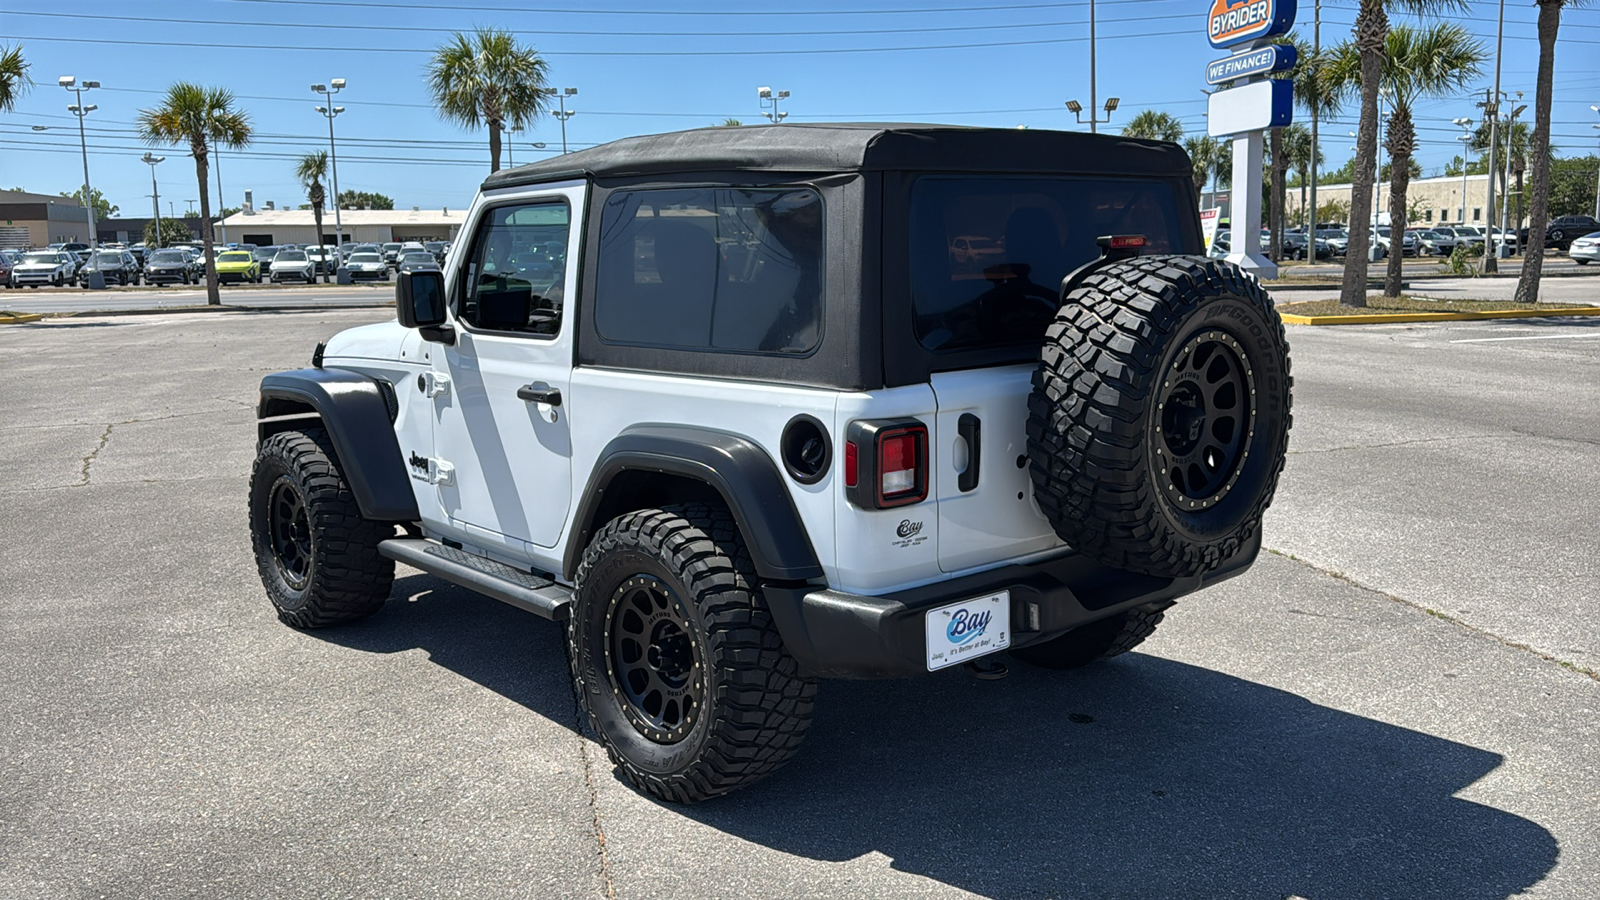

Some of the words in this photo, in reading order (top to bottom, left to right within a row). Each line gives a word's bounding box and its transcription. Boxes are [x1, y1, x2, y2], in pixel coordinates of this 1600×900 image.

[1211, 1, 1267, 36] BYRIDER
[1210, 65, 1224, 79] WE
[1225, 52, 1271, 74] FINANCE!
[409, 450, 429, 474] Jeep
[897, 519, 924, 537] Bay
[948, 608, 992, 638] Bay
[958, 643, 974, 653] Better
